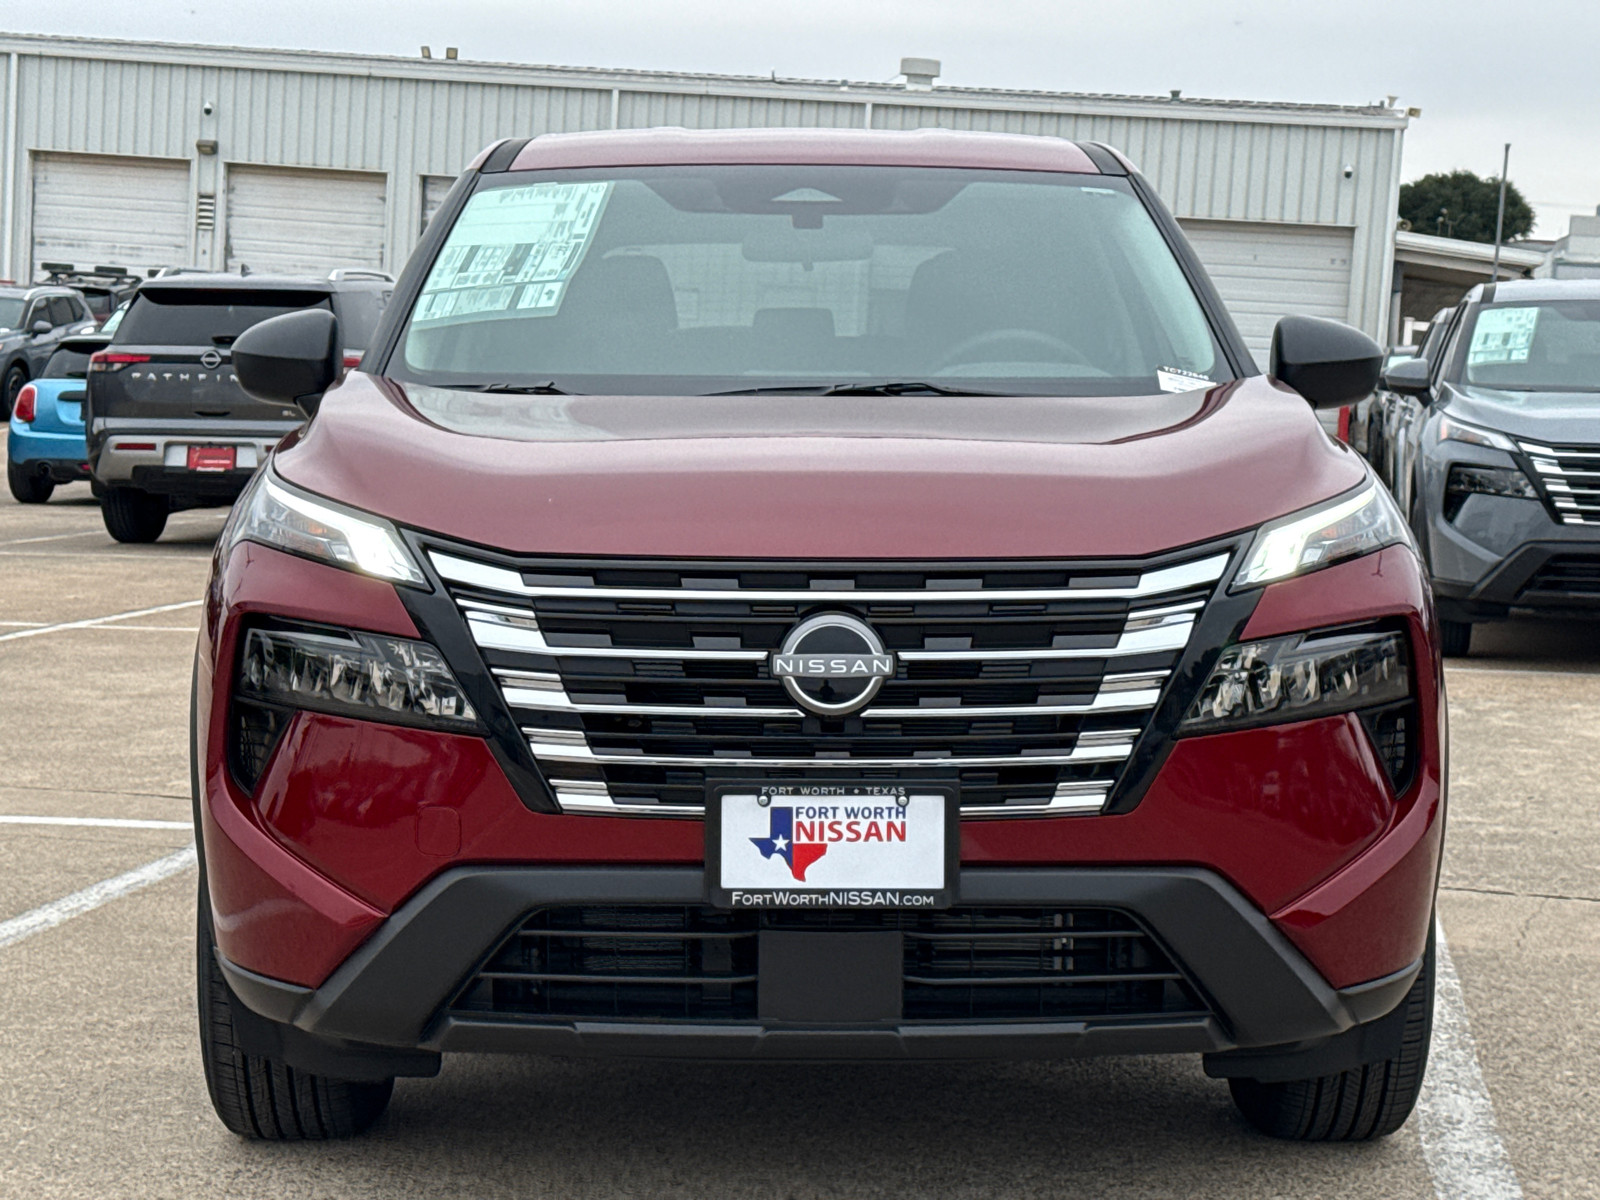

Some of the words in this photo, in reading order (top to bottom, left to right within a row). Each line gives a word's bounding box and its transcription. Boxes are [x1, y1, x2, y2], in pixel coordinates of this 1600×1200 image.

[776, 659, 890, 673] NISSAN
[761, 787, 794, 795] FORT
[800, 787, 845, 795] WORTH
[866, 787, 905, 795] TEXAS
[795, 806, 839, 819] FORT
[844, 806, 906, 819] WORTH
[795, 820, 906, 842] NISSAN
